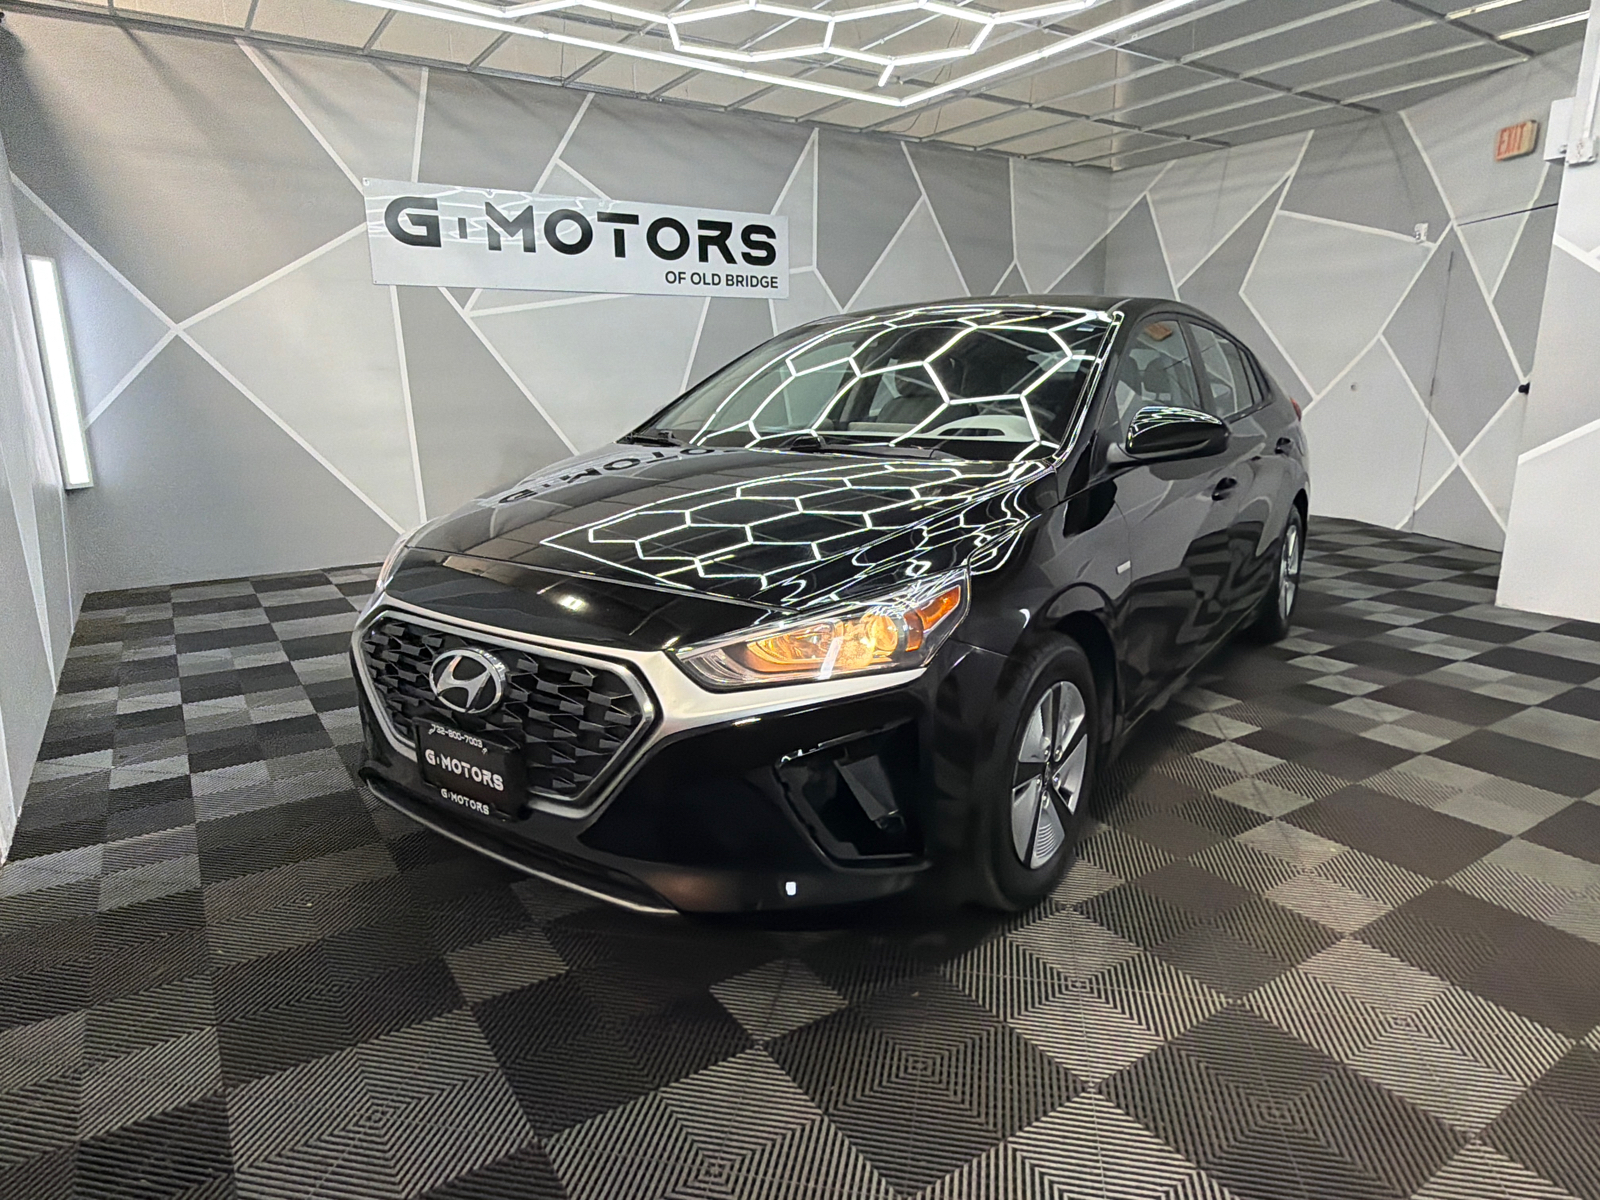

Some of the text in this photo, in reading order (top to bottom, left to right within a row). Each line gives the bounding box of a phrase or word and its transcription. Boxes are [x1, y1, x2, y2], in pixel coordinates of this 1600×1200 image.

[1496, 122, 1526, 157] EXIT
[665, 270, 779, 289] OF OLD BRIDGE
